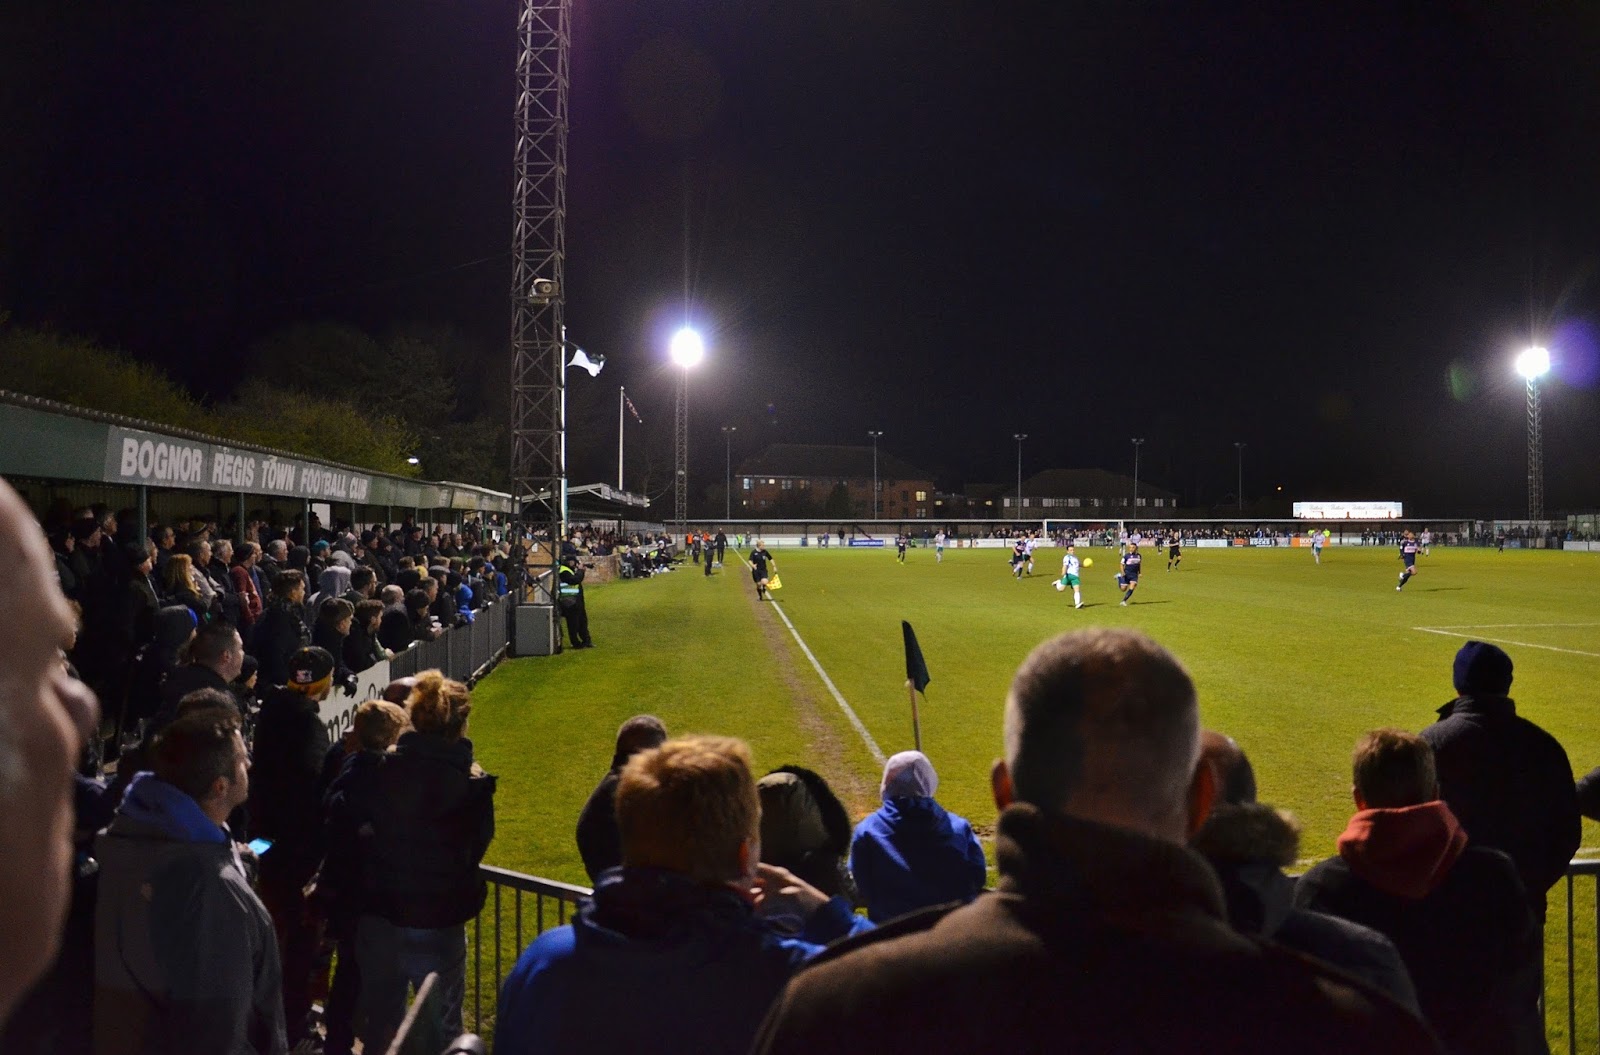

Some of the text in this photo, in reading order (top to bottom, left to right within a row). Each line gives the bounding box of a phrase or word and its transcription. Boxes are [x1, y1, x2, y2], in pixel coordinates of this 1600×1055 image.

[120, 437, 368, 500] BOGNOR REGIS TOWN FOOTBALL CLUB
